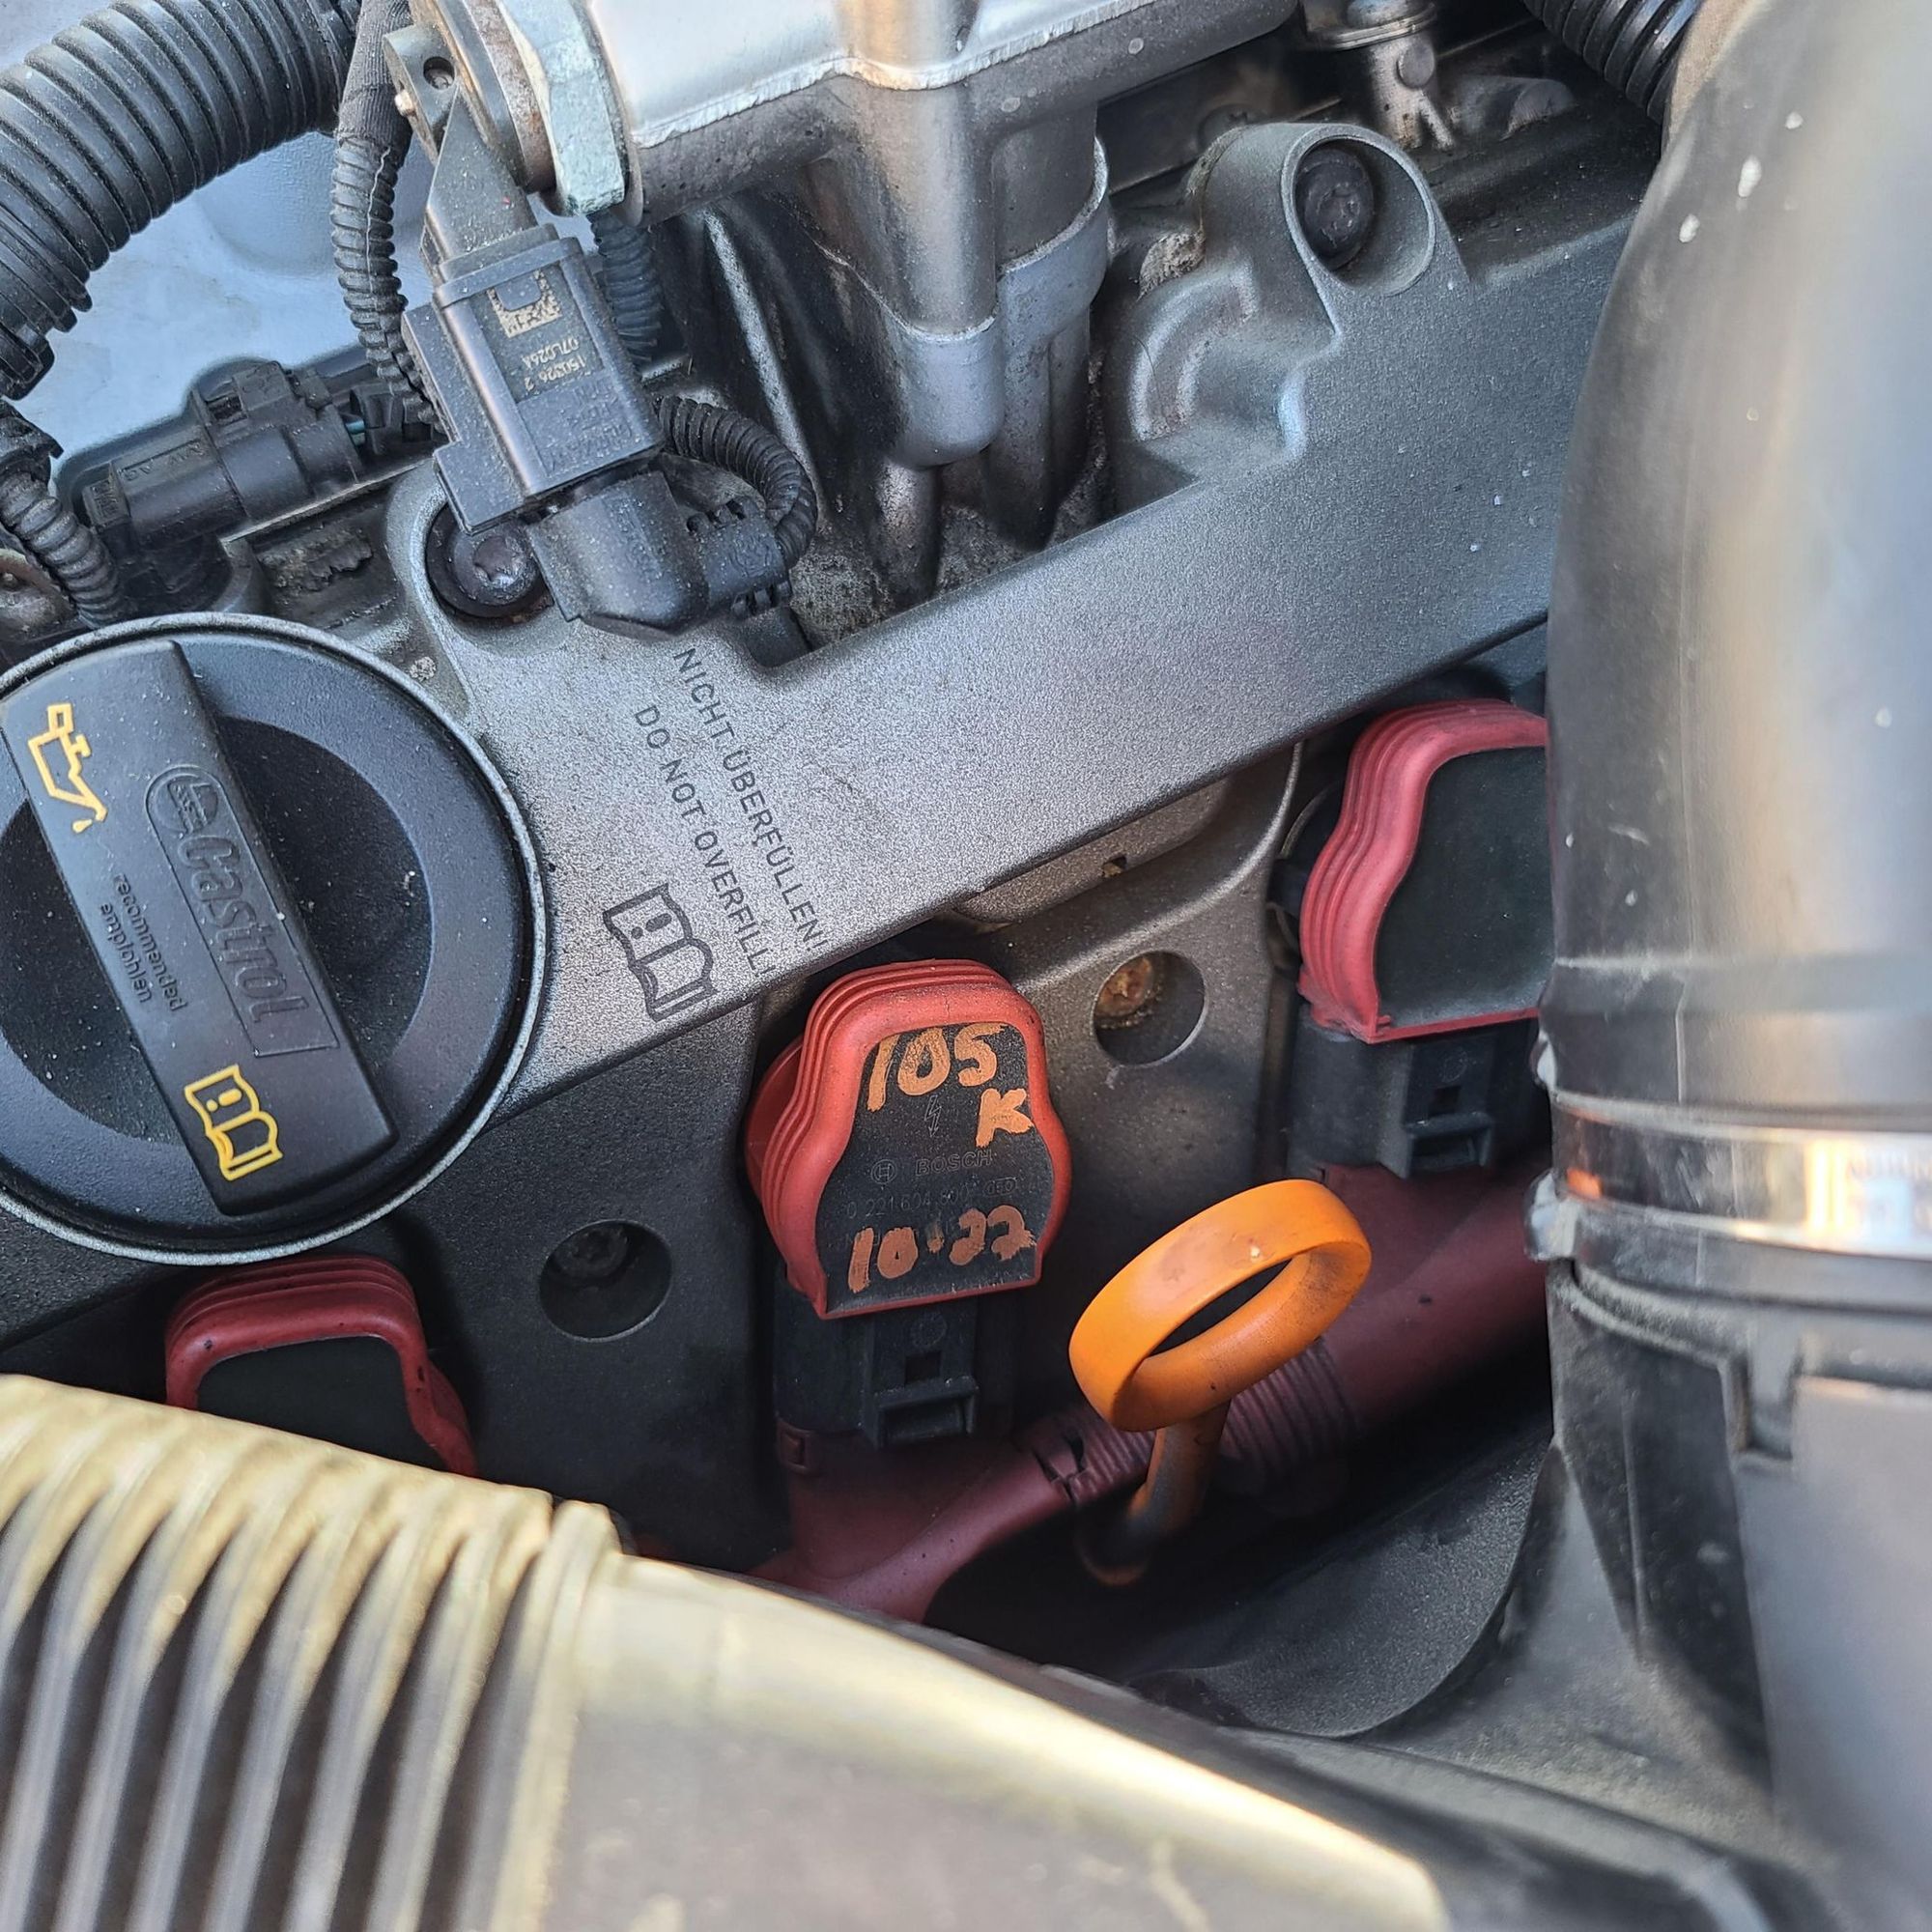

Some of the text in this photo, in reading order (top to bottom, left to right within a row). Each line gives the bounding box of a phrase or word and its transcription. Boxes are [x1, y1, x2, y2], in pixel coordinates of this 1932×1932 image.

[634, 704, 671, 750] DO
[659, 758, 707, 821] NOT
[672, 647, 829, 952] NICHT ÜBERFÜLLEN!
[113, 872, 189, 1011] recommended
[177, 835, 310, 1024] Castrol
[867, 1022, 1008, 1112] 105
[976, 1087, 1035, 1149] K
[915, 1148, 994, 1178] BOSCH
